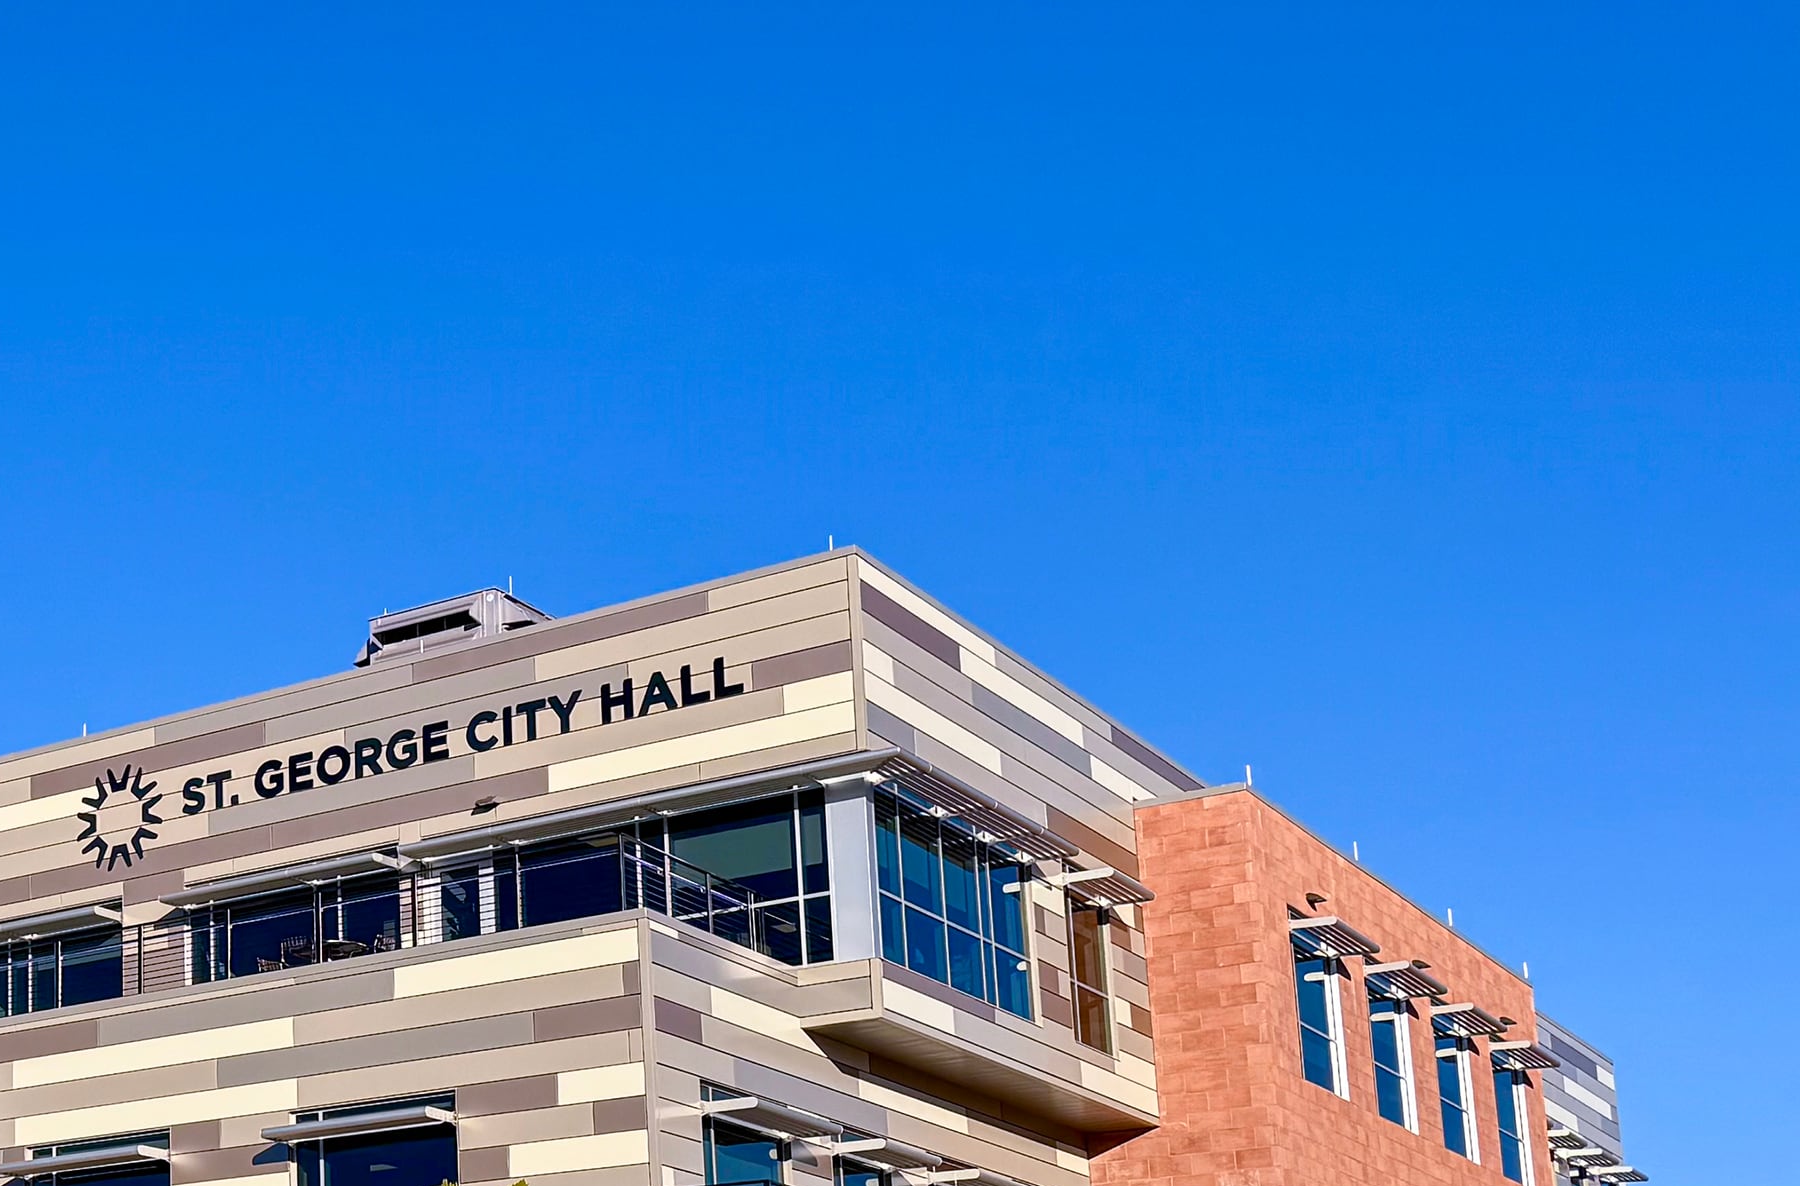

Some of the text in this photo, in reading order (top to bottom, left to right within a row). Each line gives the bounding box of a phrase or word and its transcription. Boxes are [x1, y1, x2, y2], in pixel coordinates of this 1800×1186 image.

[182, 656, 746, 815] ST. GEORGE CITY HALL
